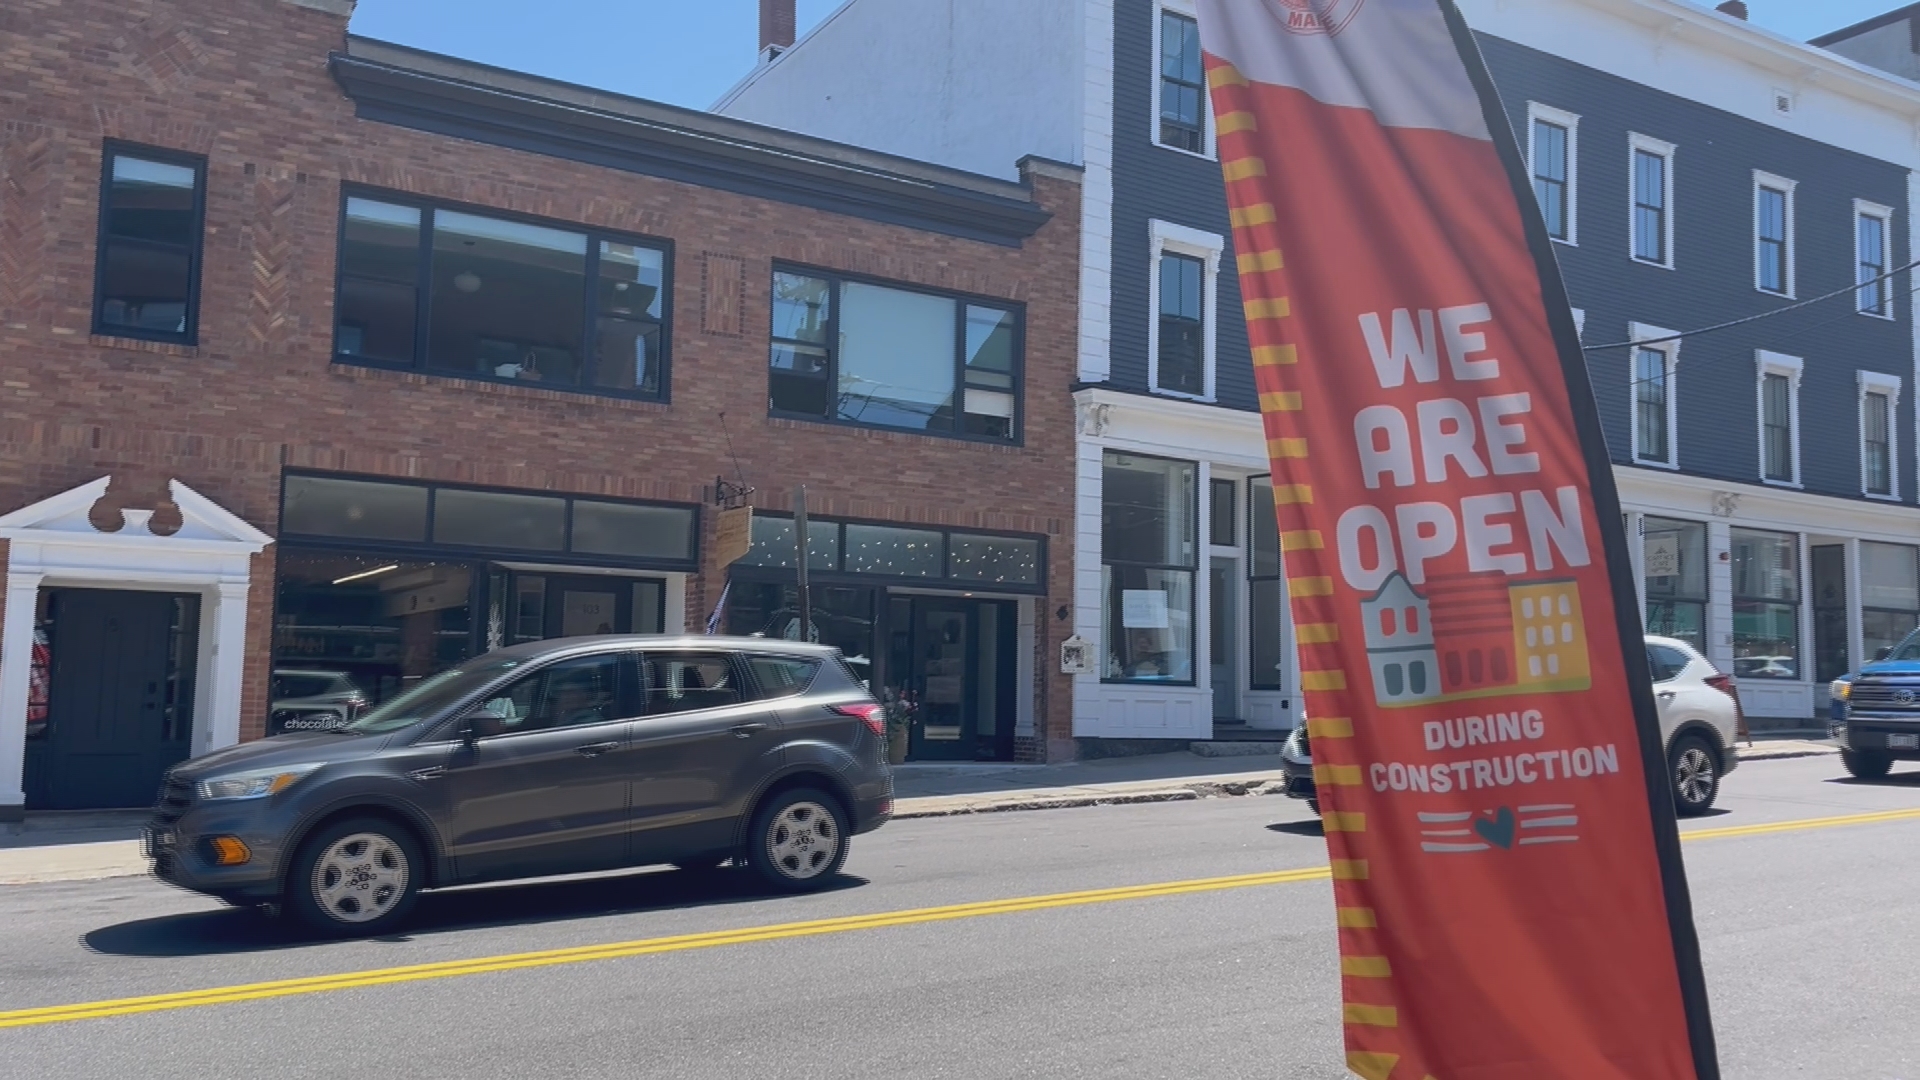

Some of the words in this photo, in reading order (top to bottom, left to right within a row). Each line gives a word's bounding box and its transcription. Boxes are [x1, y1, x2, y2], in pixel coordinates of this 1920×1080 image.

[1358, 302, 1500, 388] WE
[1353, 392, 1541, 489] ARE
[1336, 485, 1592, 591] OPEN
[1369, 743, 1619, 793] CONSTRUCTION
[1423, 709, 1545, 751] DURING
